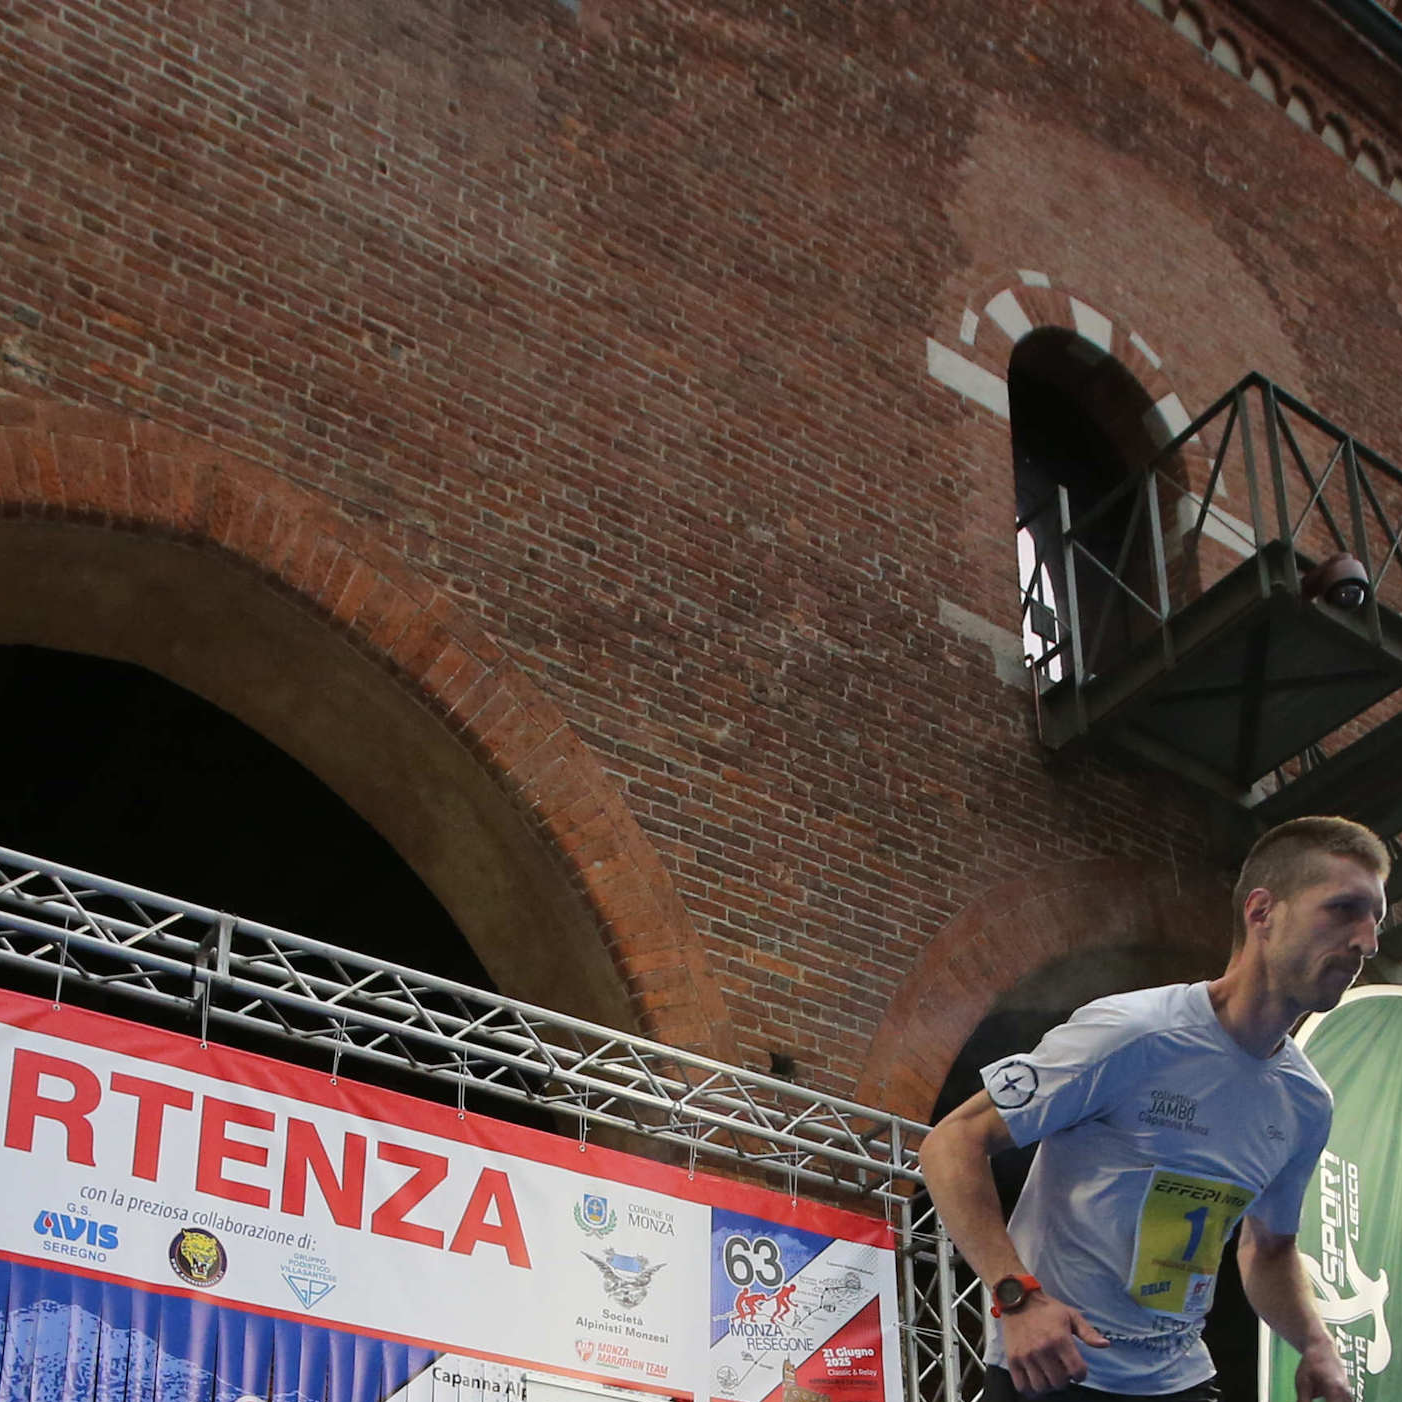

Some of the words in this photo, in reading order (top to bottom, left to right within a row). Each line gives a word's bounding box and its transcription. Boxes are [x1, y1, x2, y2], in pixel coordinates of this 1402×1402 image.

[1154, 1179, 1221, 1202] EFFEPI
[66, 1201, 93, 1218] G.S.
[1349, 1162, 1360, 1242] LECCO
[79, 1183, 107, 1204] con
[110, 1187, 124, 1207] la
[126, 1194, 190, 1223] preziosa
[192, 1210, 295, 1247] collaborazione
[296, 1232, 317, 1253] di:
[628, 1203, 663, 1218] COMUNE
[665, 1213, 674, 1222] DI
[33, 1209, 119, 1251] AVIS
[628, 1213, 676, 1237] MONZA
[42, 1239, 107, 1264] SEREGNO
[293, 1252, 327, 1265] GRUPPO
[287, 1258, 331, 1275] PODISTICO
[724, 1236, 784, 1288] 63
[280, 1264, 337, 1283] VILLASANTESE
[1140, 1280, 1172, 1297] RELAY
[602, 1308, 644, 1326] Società
[575, 1316, 623, 1335] Alpinisti
[625, 1325, 671, 1344] Monzesi
[729, 1323, 785, 1338] MONZA
[597, 1342, 630, 1357] MONZA
[746, 1336, 815, 1352] RESEGONE
[821, 1347, 835, 1358] 21
[835, 1346, 875, 1359] Giugno
[597, 1351, 645, 1371] MARATHON
[646, 1361, 669, 1376] TEAM
[824, 1357, 852, 1368] 2025
[432, 1367, 501, 1393] Capanna
[827, 1368, 852, 1377] Classic
[859, 1368, 878, 1378] Relay
